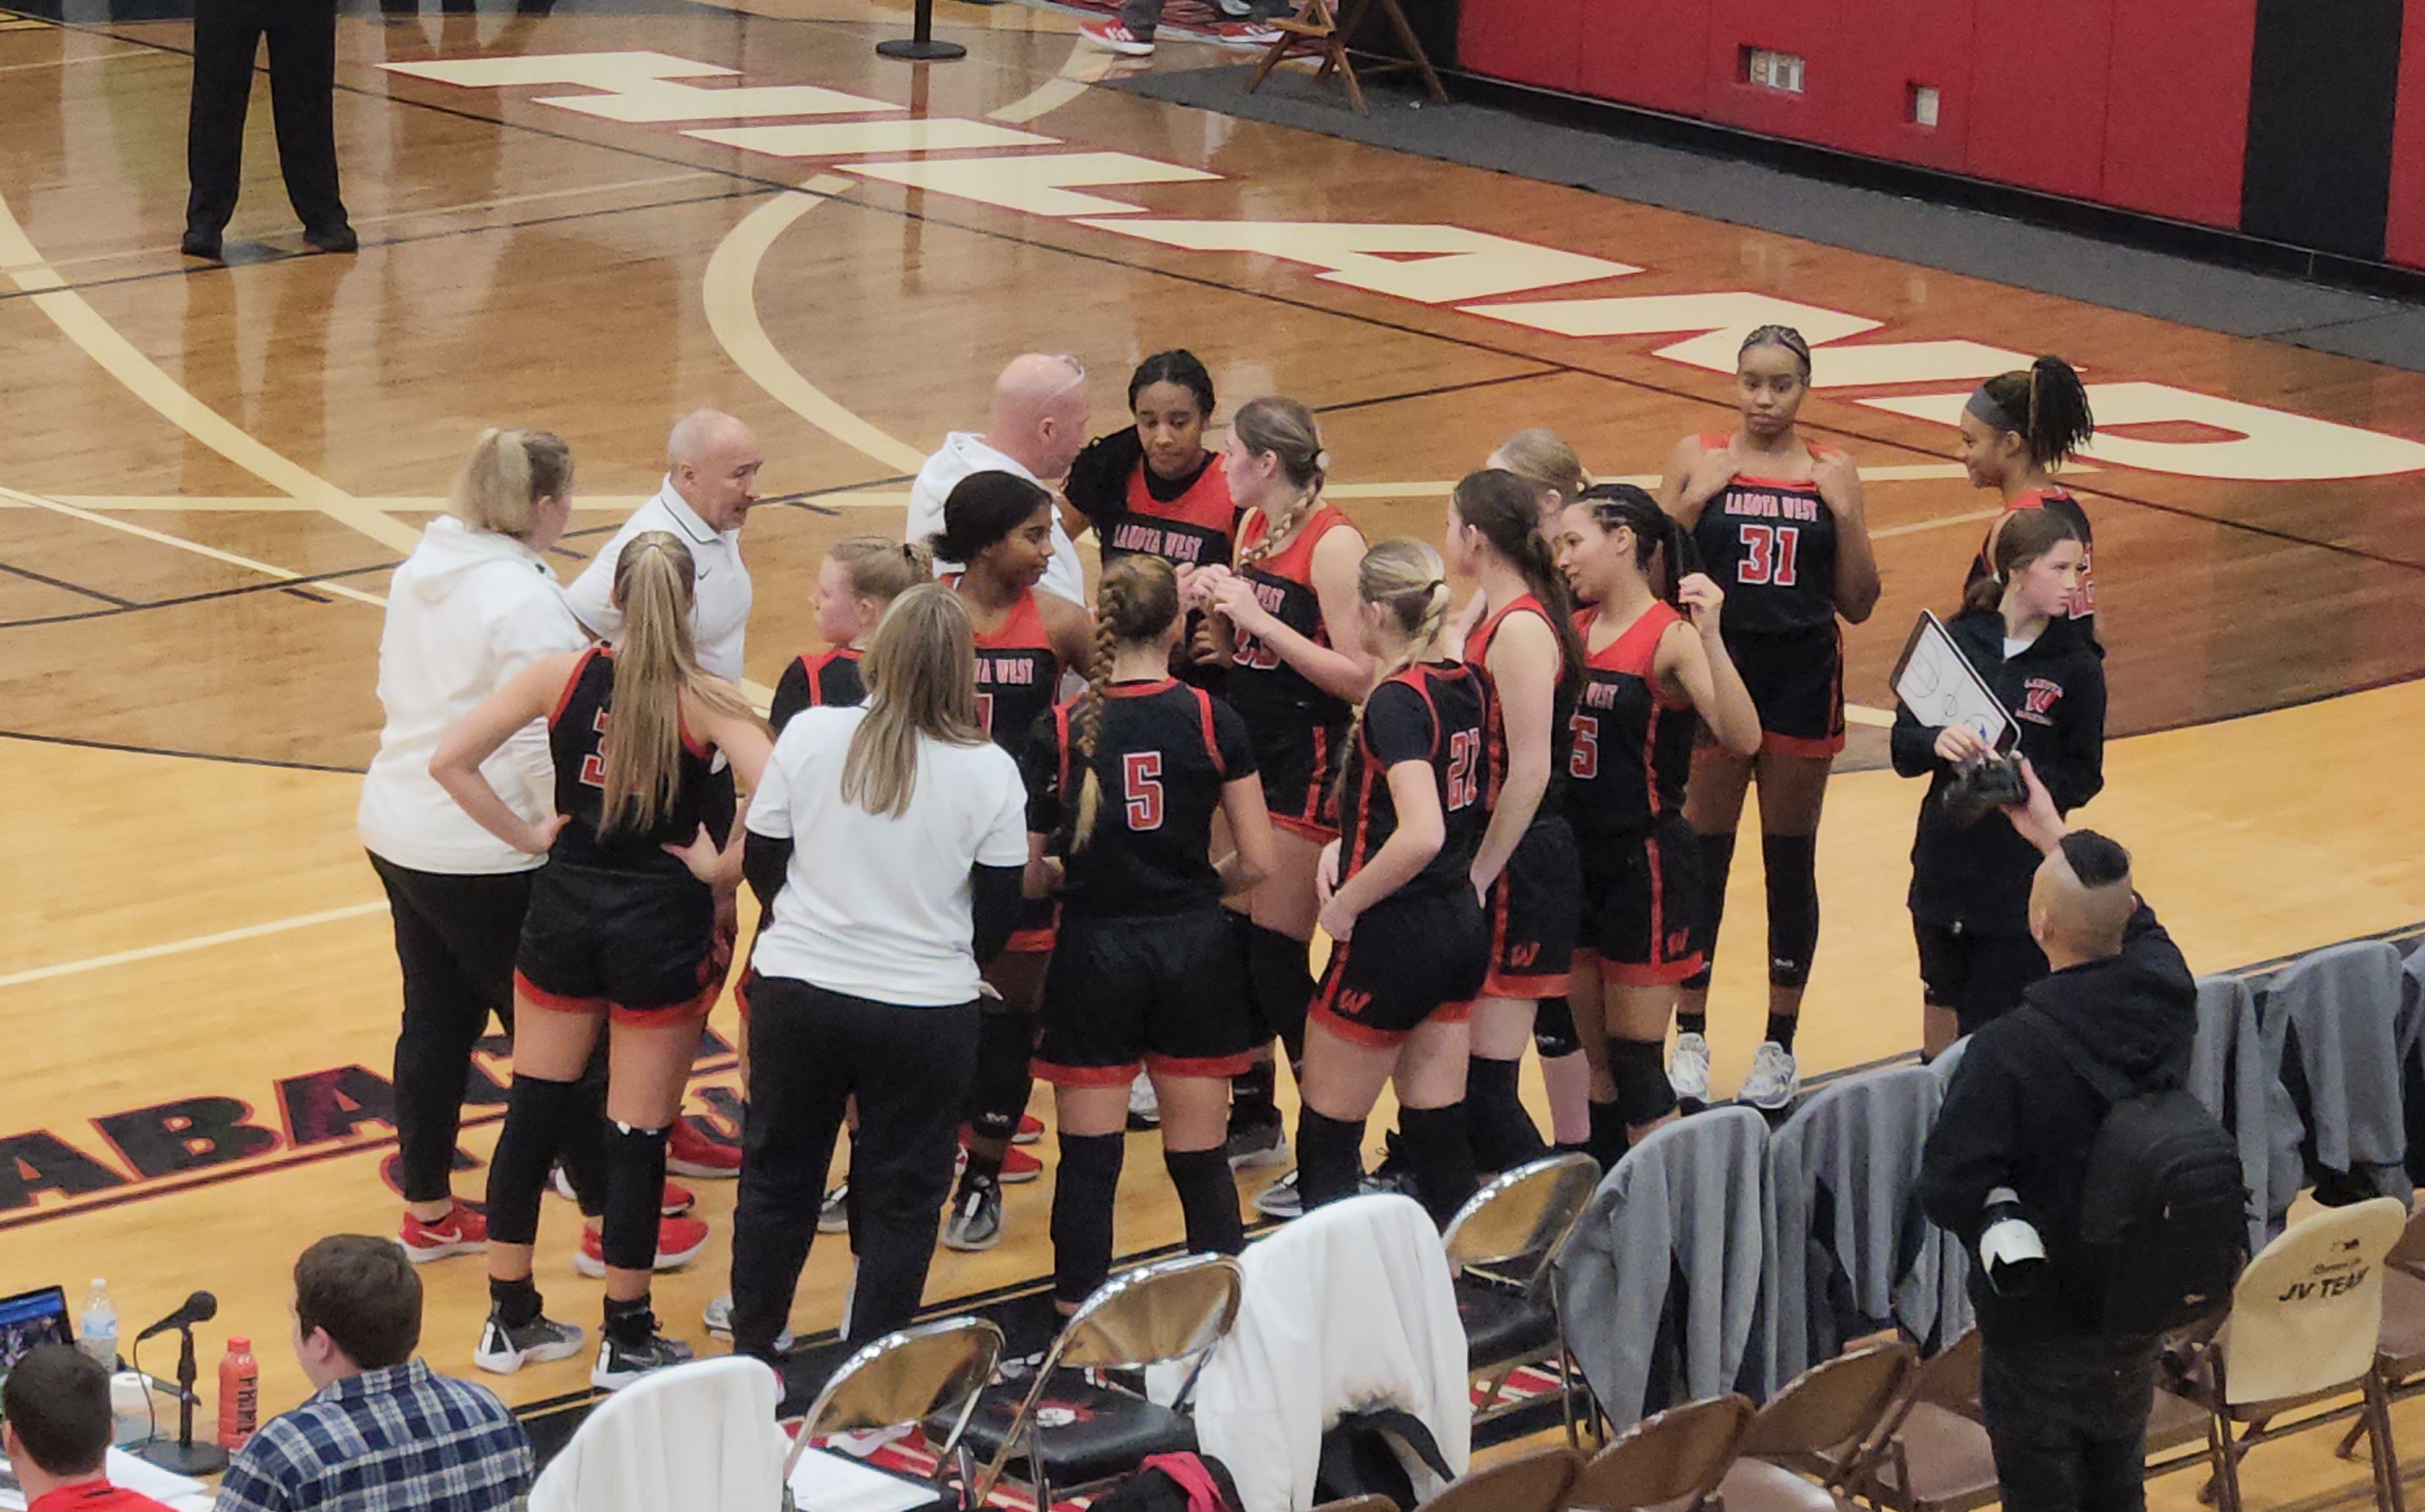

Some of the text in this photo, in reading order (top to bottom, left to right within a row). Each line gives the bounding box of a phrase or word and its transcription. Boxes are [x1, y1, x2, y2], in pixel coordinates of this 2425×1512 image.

[1781, 496, 1817, 522] WEST
[1737, 523, 1799, 586] 31
[995, 658, 1033, 684] WEST
[1123, 750, 1164, 832] 5
[1338, 987, 1372, 1015] W
[2279, 1282, 2316, 1302] JV
